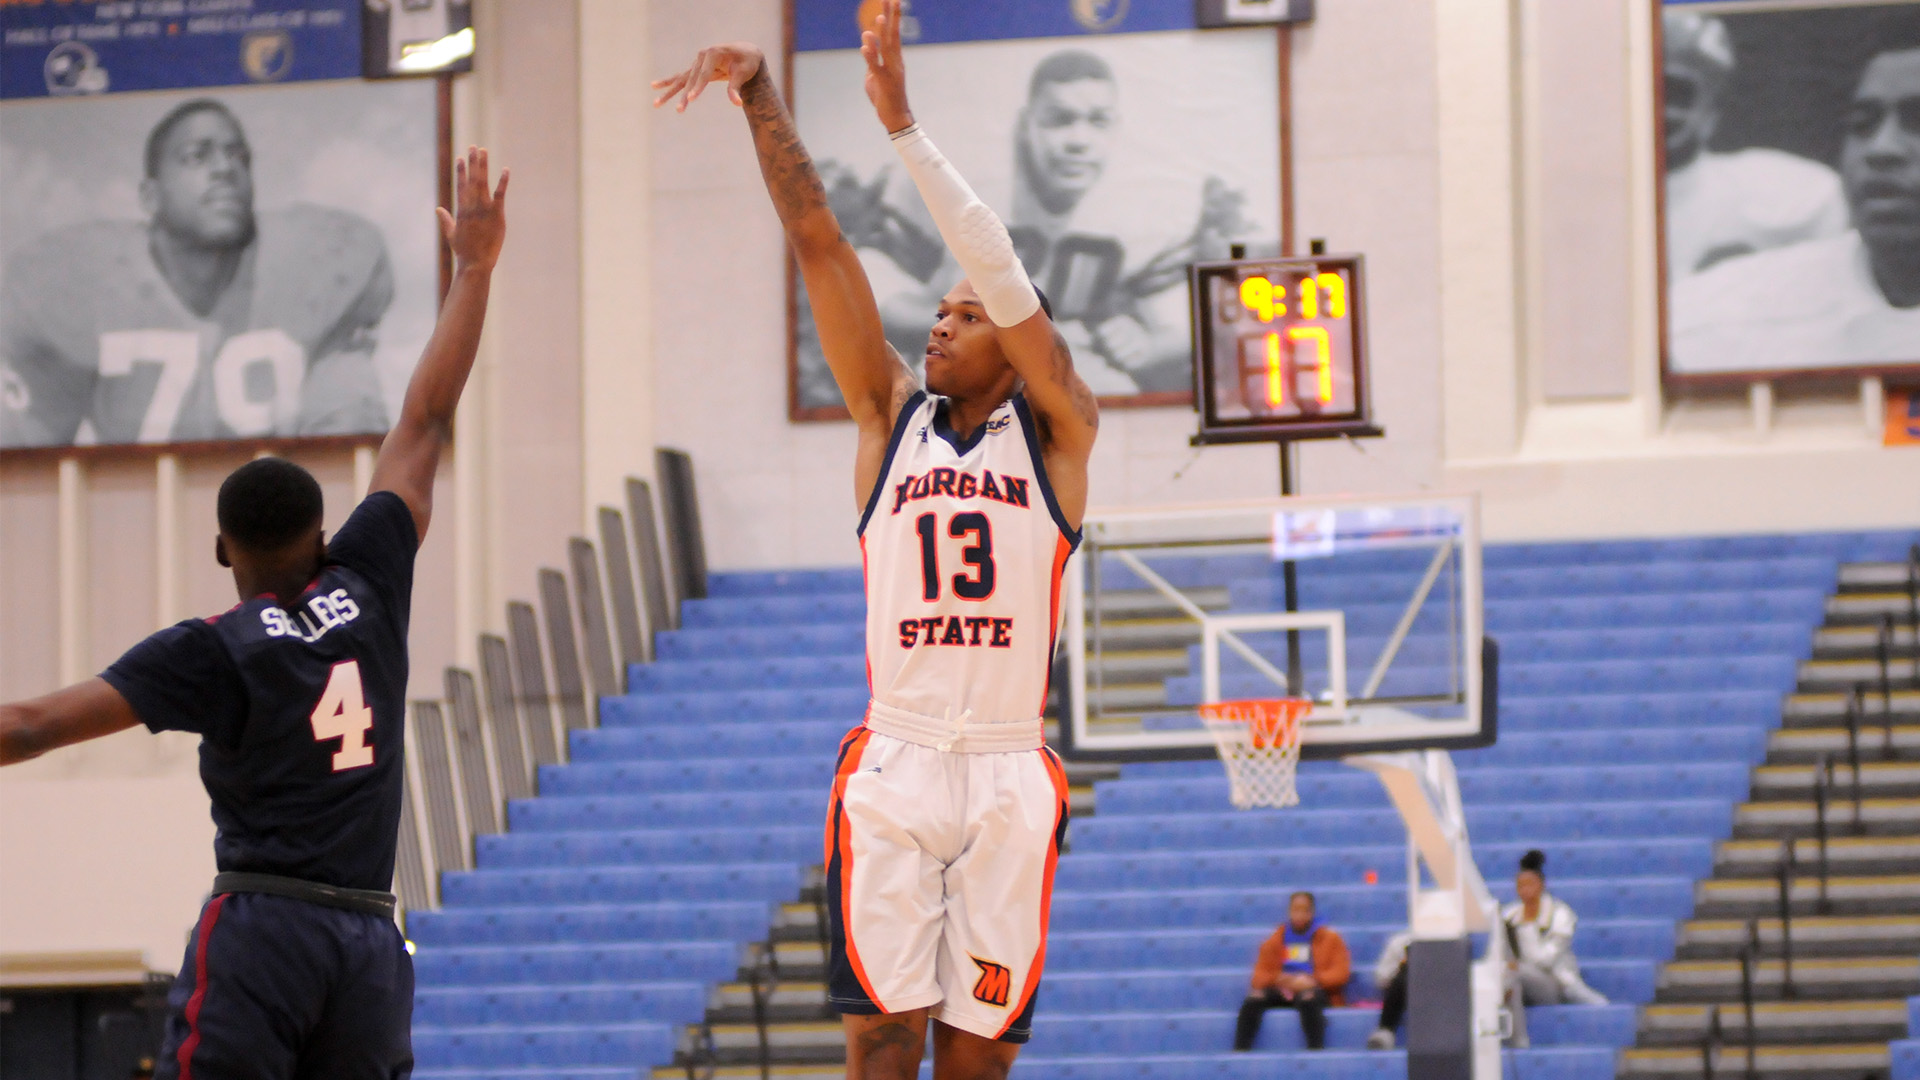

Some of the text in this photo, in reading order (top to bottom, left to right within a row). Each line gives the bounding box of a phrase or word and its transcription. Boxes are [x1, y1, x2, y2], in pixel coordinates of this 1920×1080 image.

[1238, 271, 1347, 324] 9:17
[99, 328, 306, 445] 79
[1263, 324, 1336, 410] 17
[986, 413, 1011, 430] EAC
[915, 510, 997, 603] 13
[898, 615, 1014, 650] STATE
[309, 657, 375, 774] 4
